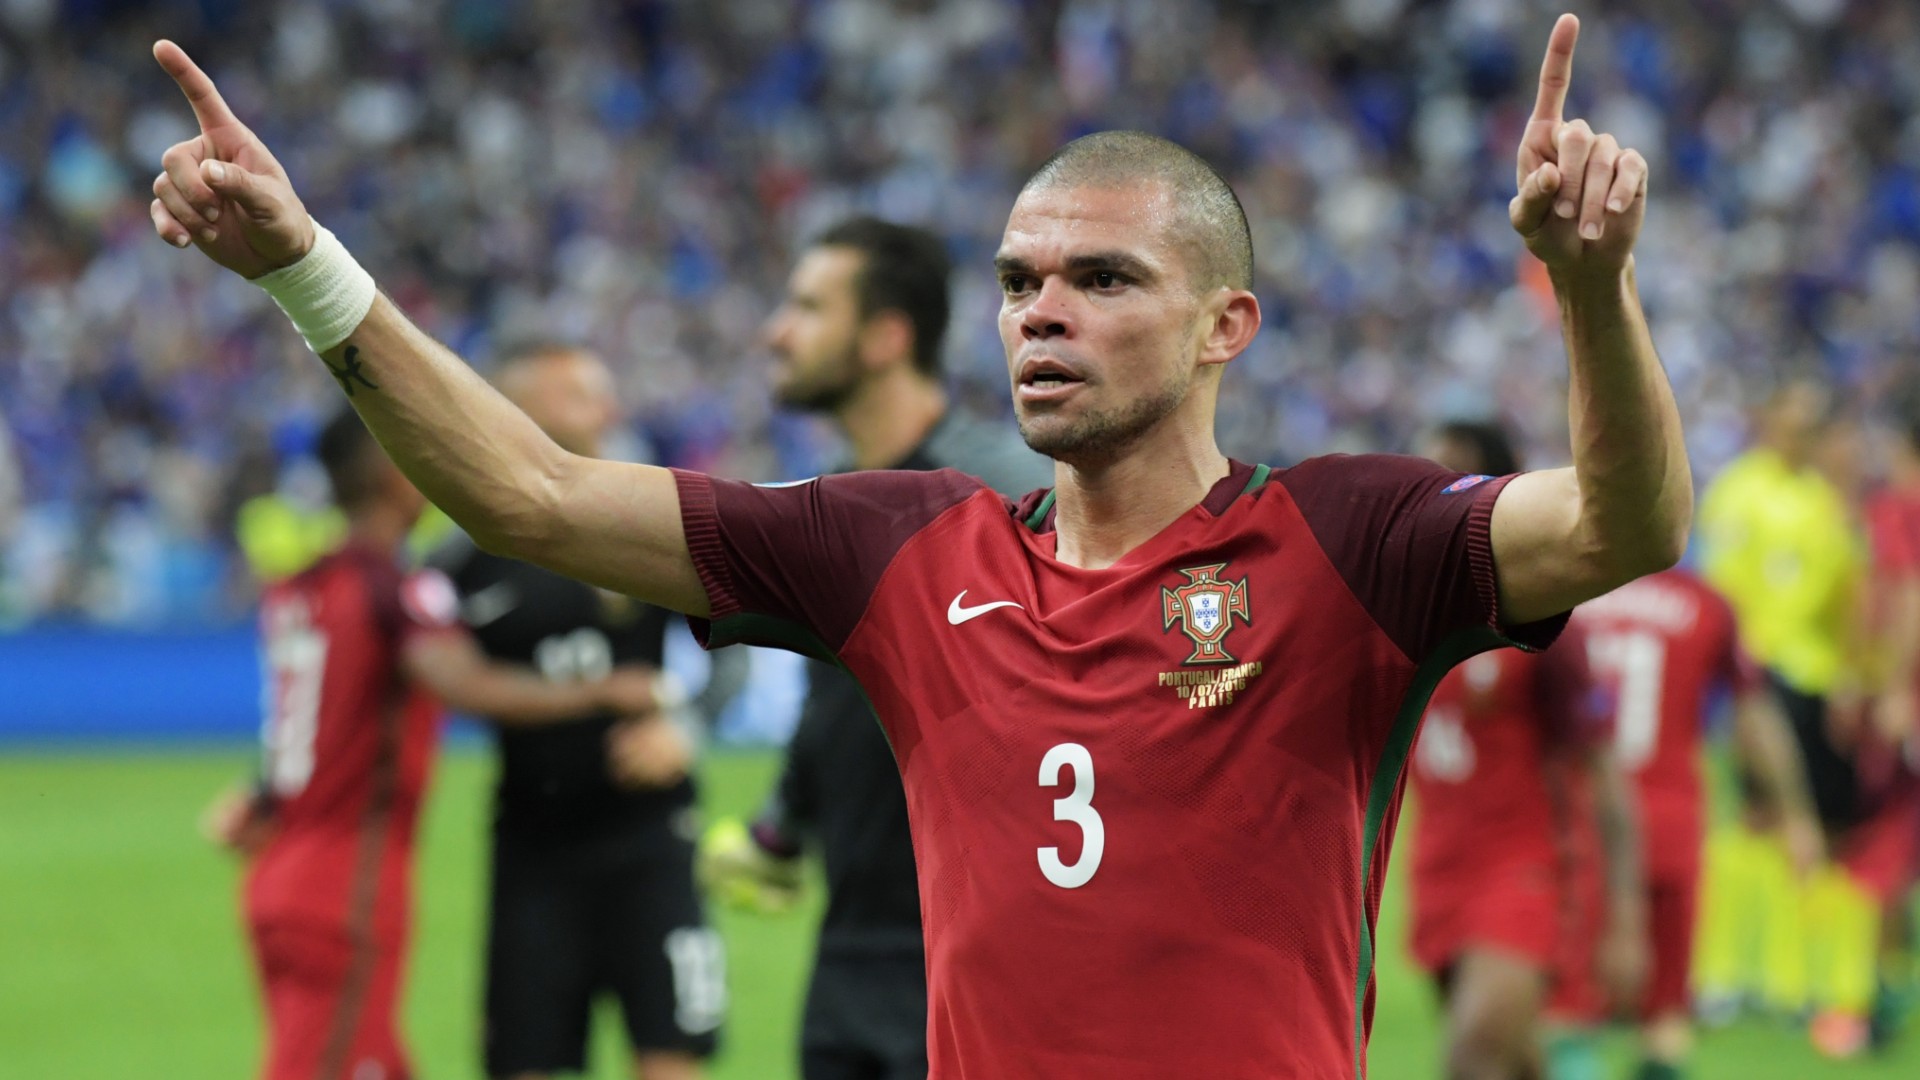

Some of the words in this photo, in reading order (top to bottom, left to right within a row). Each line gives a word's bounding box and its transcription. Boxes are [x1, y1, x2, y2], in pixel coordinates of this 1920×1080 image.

[1177, 679, 1246, 698] 10/07/2016
[1189, 692, 1233, 709] PARIS
[1037, 742, 1105, 889] 3
